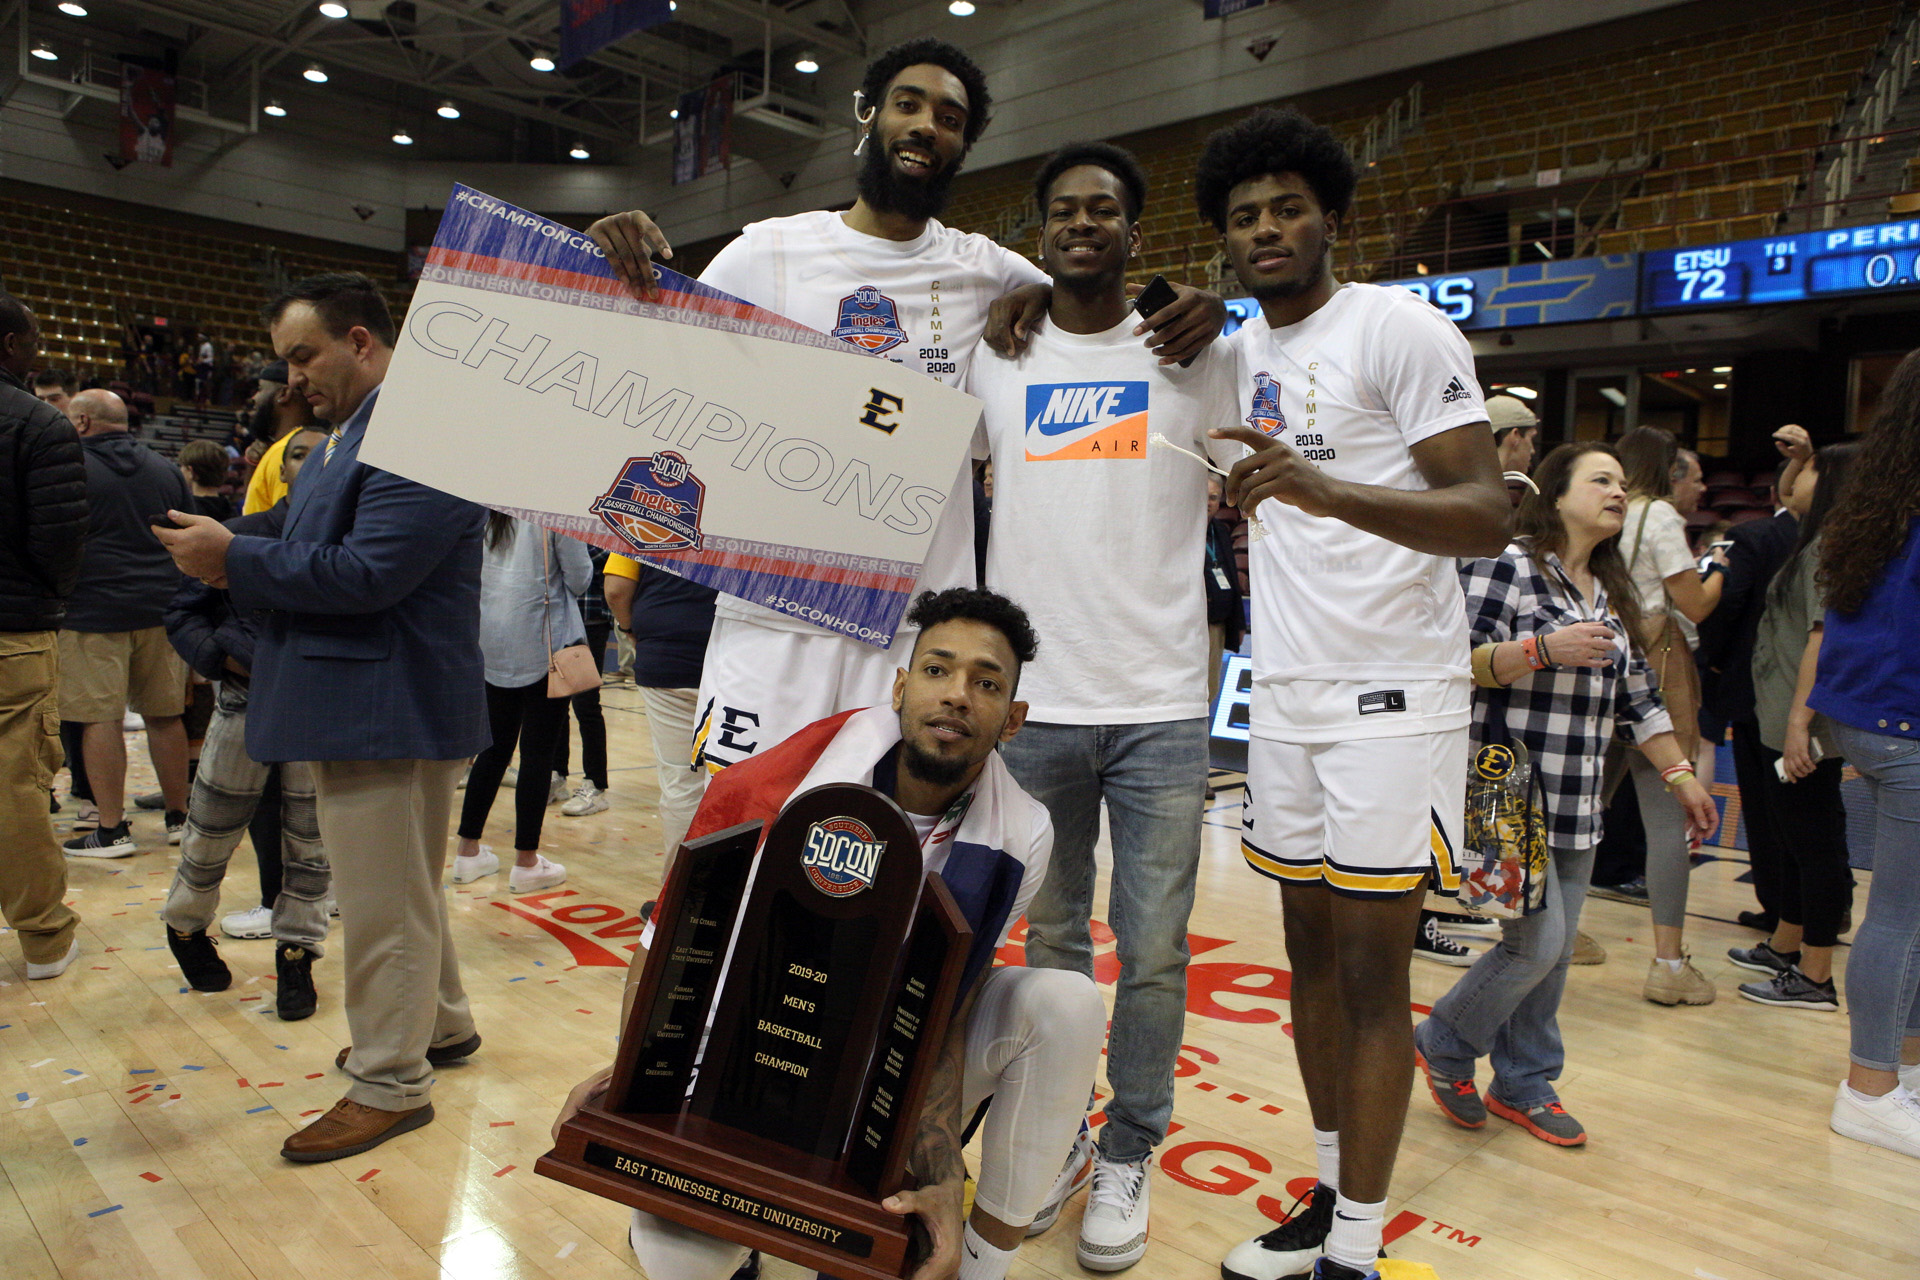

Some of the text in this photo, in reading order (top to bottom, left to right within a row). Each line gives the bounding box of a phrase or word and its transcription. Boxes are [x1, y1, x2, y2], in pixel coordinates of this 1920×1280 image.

[1674, 247, 1731, 272] ETSU
[1764, 241, 1798, 256] TOL
[1772, 257, 1786, 271] 3
[1676, 268, 1727, 301] 72
[421, 265, 525, 295] SOUTHERN
[528, 282, 649, 315] CONFERENCE
[655, 306, 754, 335] SOUTHERN
[852, 315, 885, 326] ingles
[919, 348, 948, 359] 2019
[927, 362, 956, 373] 2020
[1041, 386, 1126, 424] NIKE
[409, 301, 946, 535] CHAMPIONS
[1091, 440, 1138, 452] AIR
[1295, 434, 1323, 446] 2019
[1303, 448, 1336, 461] 2020
[649, 453, 690, 484] SOCON
[631, 485, 681, 516] ingles
[604, 500, 645, 516] BASKETBALL
[645, 508, 695, 539] CHAMPIONSHIPS
[615, 525, 637, 544] ASHEVILLE
[634, 556, 682, 577] General Shale
[715, 536, 809, 562] SOUTHERN
[811, 552, 922, 577] CONFERENCE
[765, 594, 893, 646] #SOCONHOOPS
[1391, 697, 1398, 705] L
[828, 822, 868, 840] SOUTHERN
[803, 825, 883, 883] SOCON
[811, 868, 859, 892] CONFERENCE
[788, 963, 828, 984] 2019-20
[782, 994, 816, 1013] MEN'S
[757, 1019, 822, 1050] BASKETBALL
[754, 1052, 809, 1078] CHAMPION
[615, 1156, 842, 1243] EAST TENNESSEE STATE UNIVERSITY
[1431, 1220, 1482, 1248] TM
